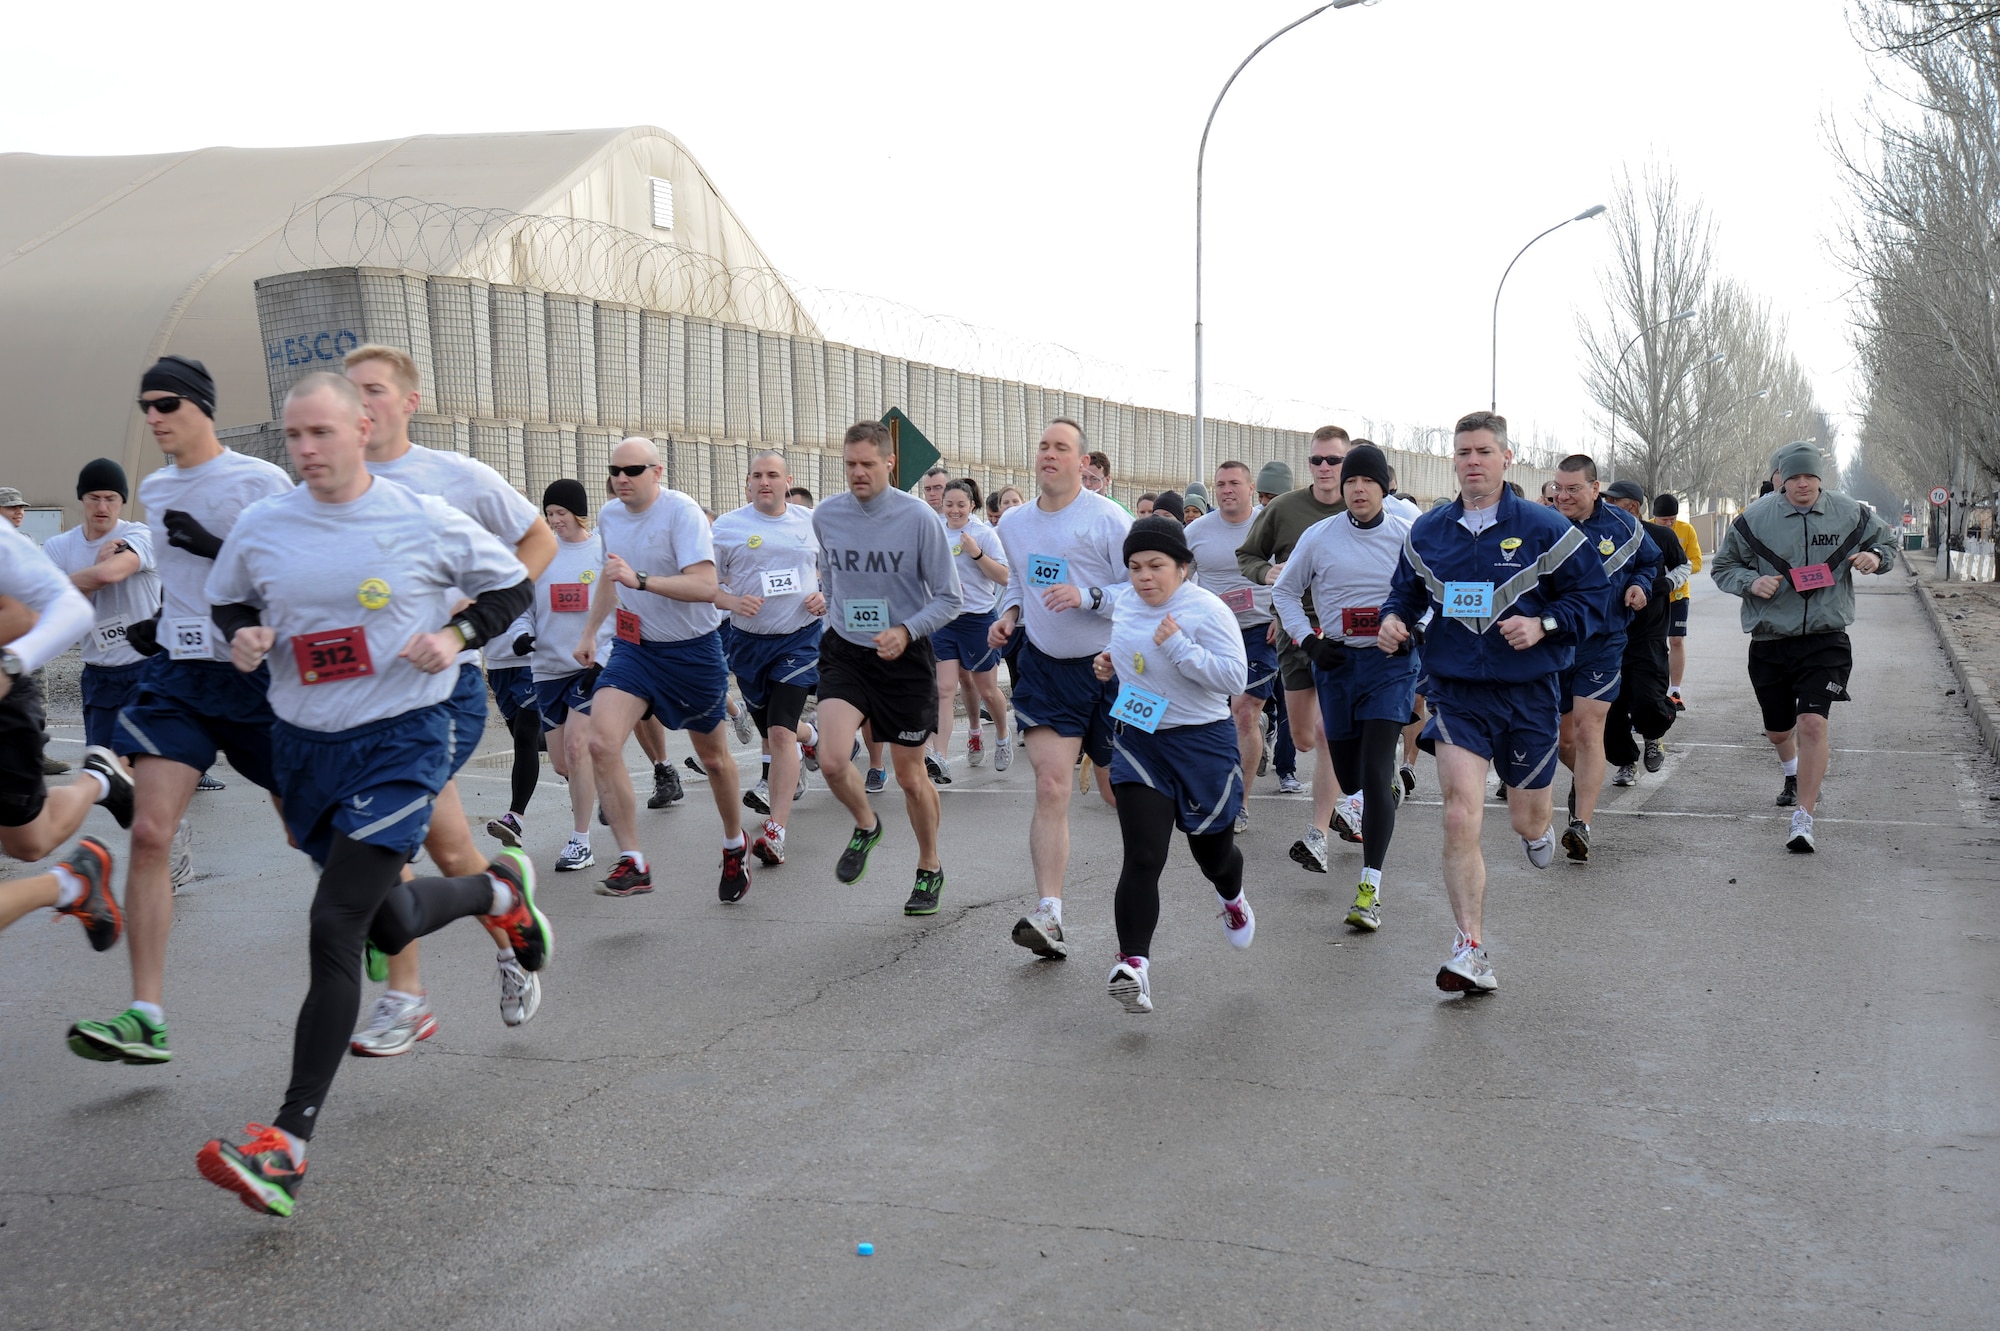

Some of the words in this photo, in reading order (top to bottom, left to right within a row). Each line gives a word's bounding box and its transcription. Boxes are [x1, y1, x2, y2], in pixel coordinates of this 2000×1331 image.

[269, 330, 358, 371] HESCO
[1933, 492, 1945, 500] 10
[1811, 534, 1840, 546] ARMY
[829, 549, 905, 573] ARMY
[1035, 566, 1060, 580] 407
[1800, 571, 1824, 583] 328
[769, 577, 792, 588] 124
[558, 593, 581, 603] 302
[1453, 594, 1483, 607] 403
[853, 610, 880, 621] 402
[1351, 617, 1379, 628] 305
[102, 628, 130, 644] 108
[179, 634, 207, 649] 103
[310, 645, 357, 669] 312
[1124, 698, 1154, 718] 400
[897, 729, 927, 742] ARMY
